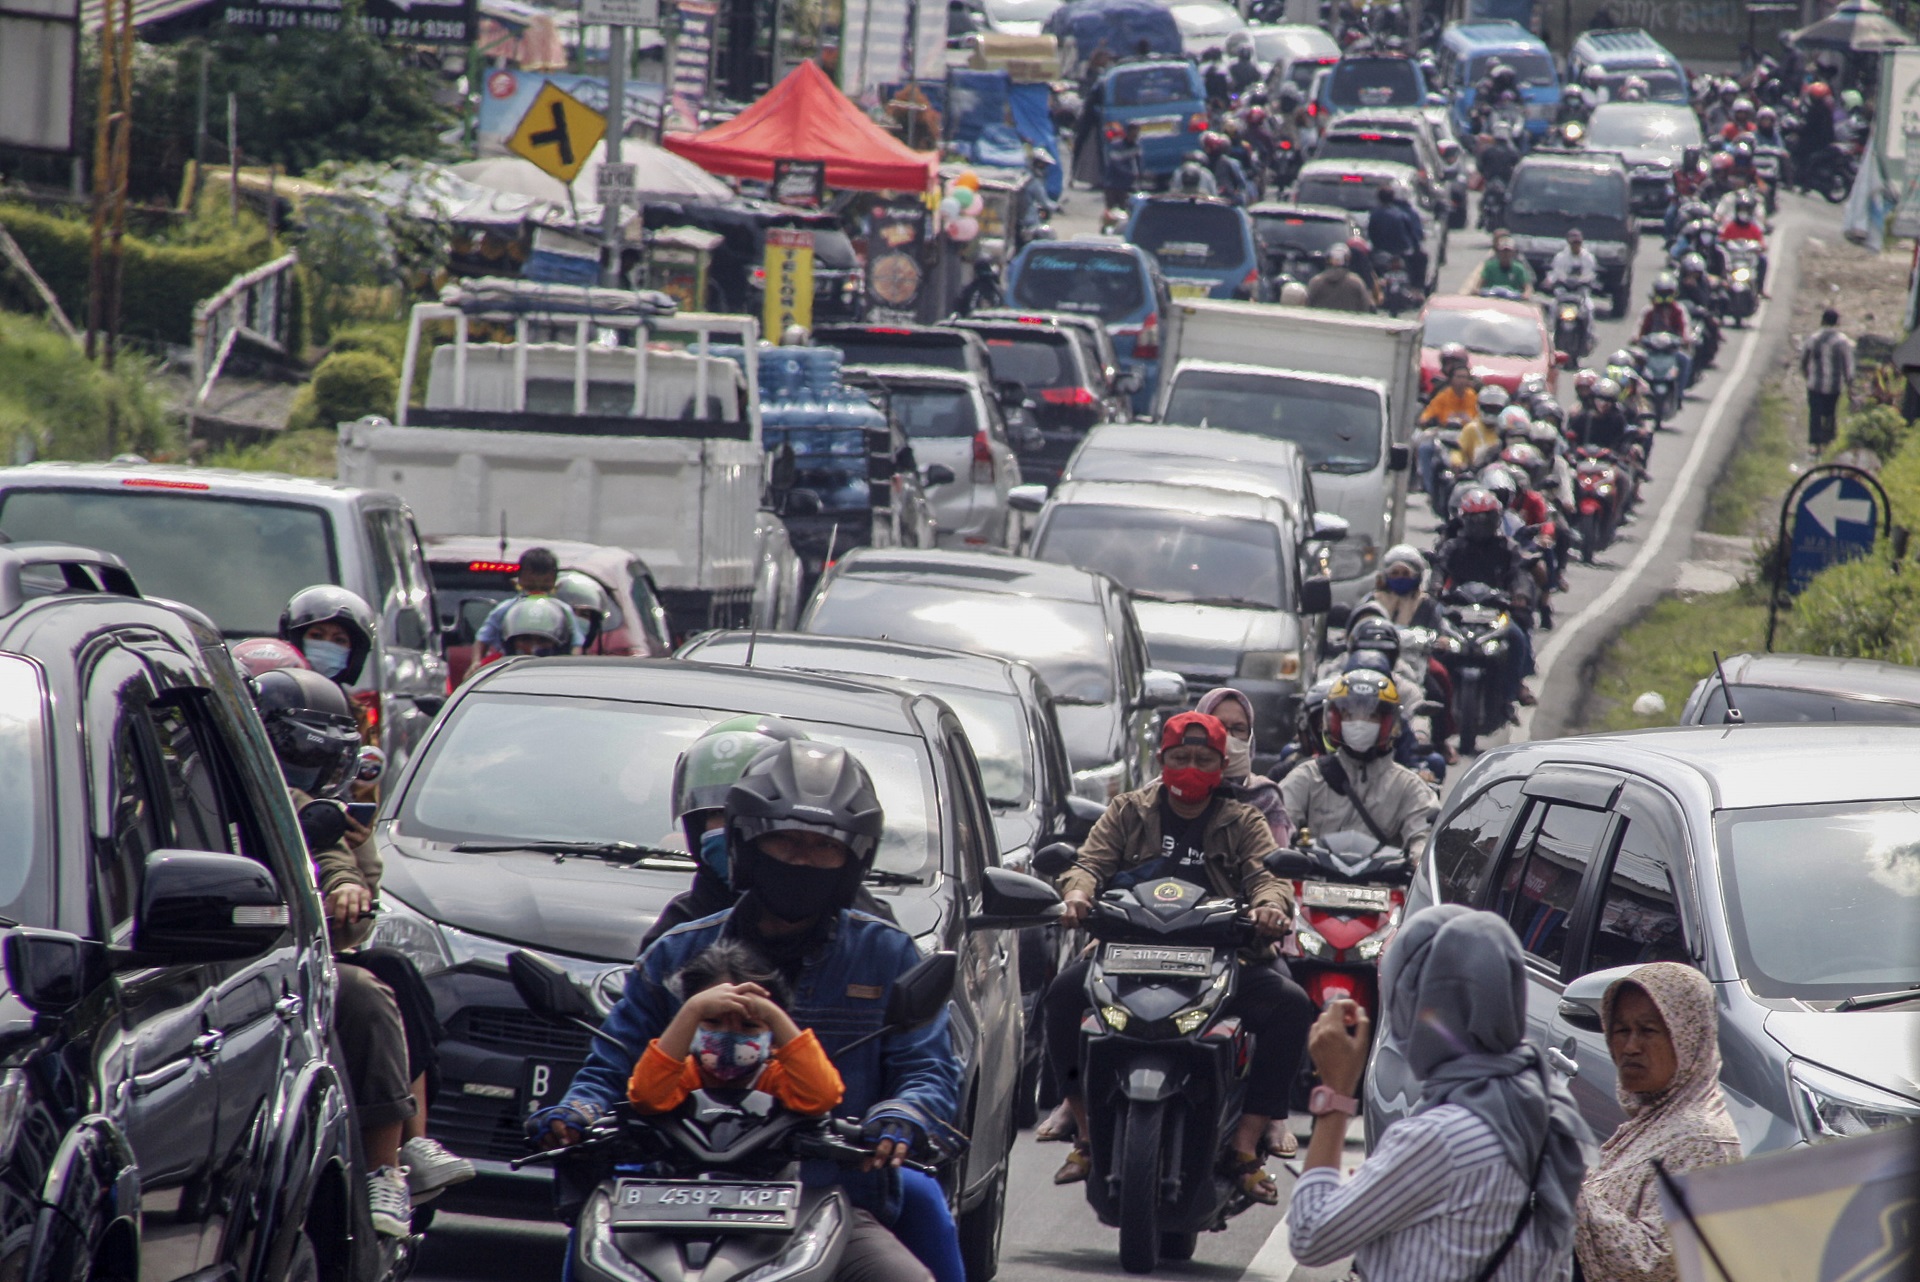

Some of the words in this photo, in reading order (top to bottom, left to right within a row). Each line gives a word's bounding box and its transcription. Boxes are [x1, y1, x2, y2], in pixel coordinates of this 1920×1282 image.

[532, 1065, 550, 1097] B
[627, 1189, 642, 1204] B
[658, 1188, 723, 1205] 4592
